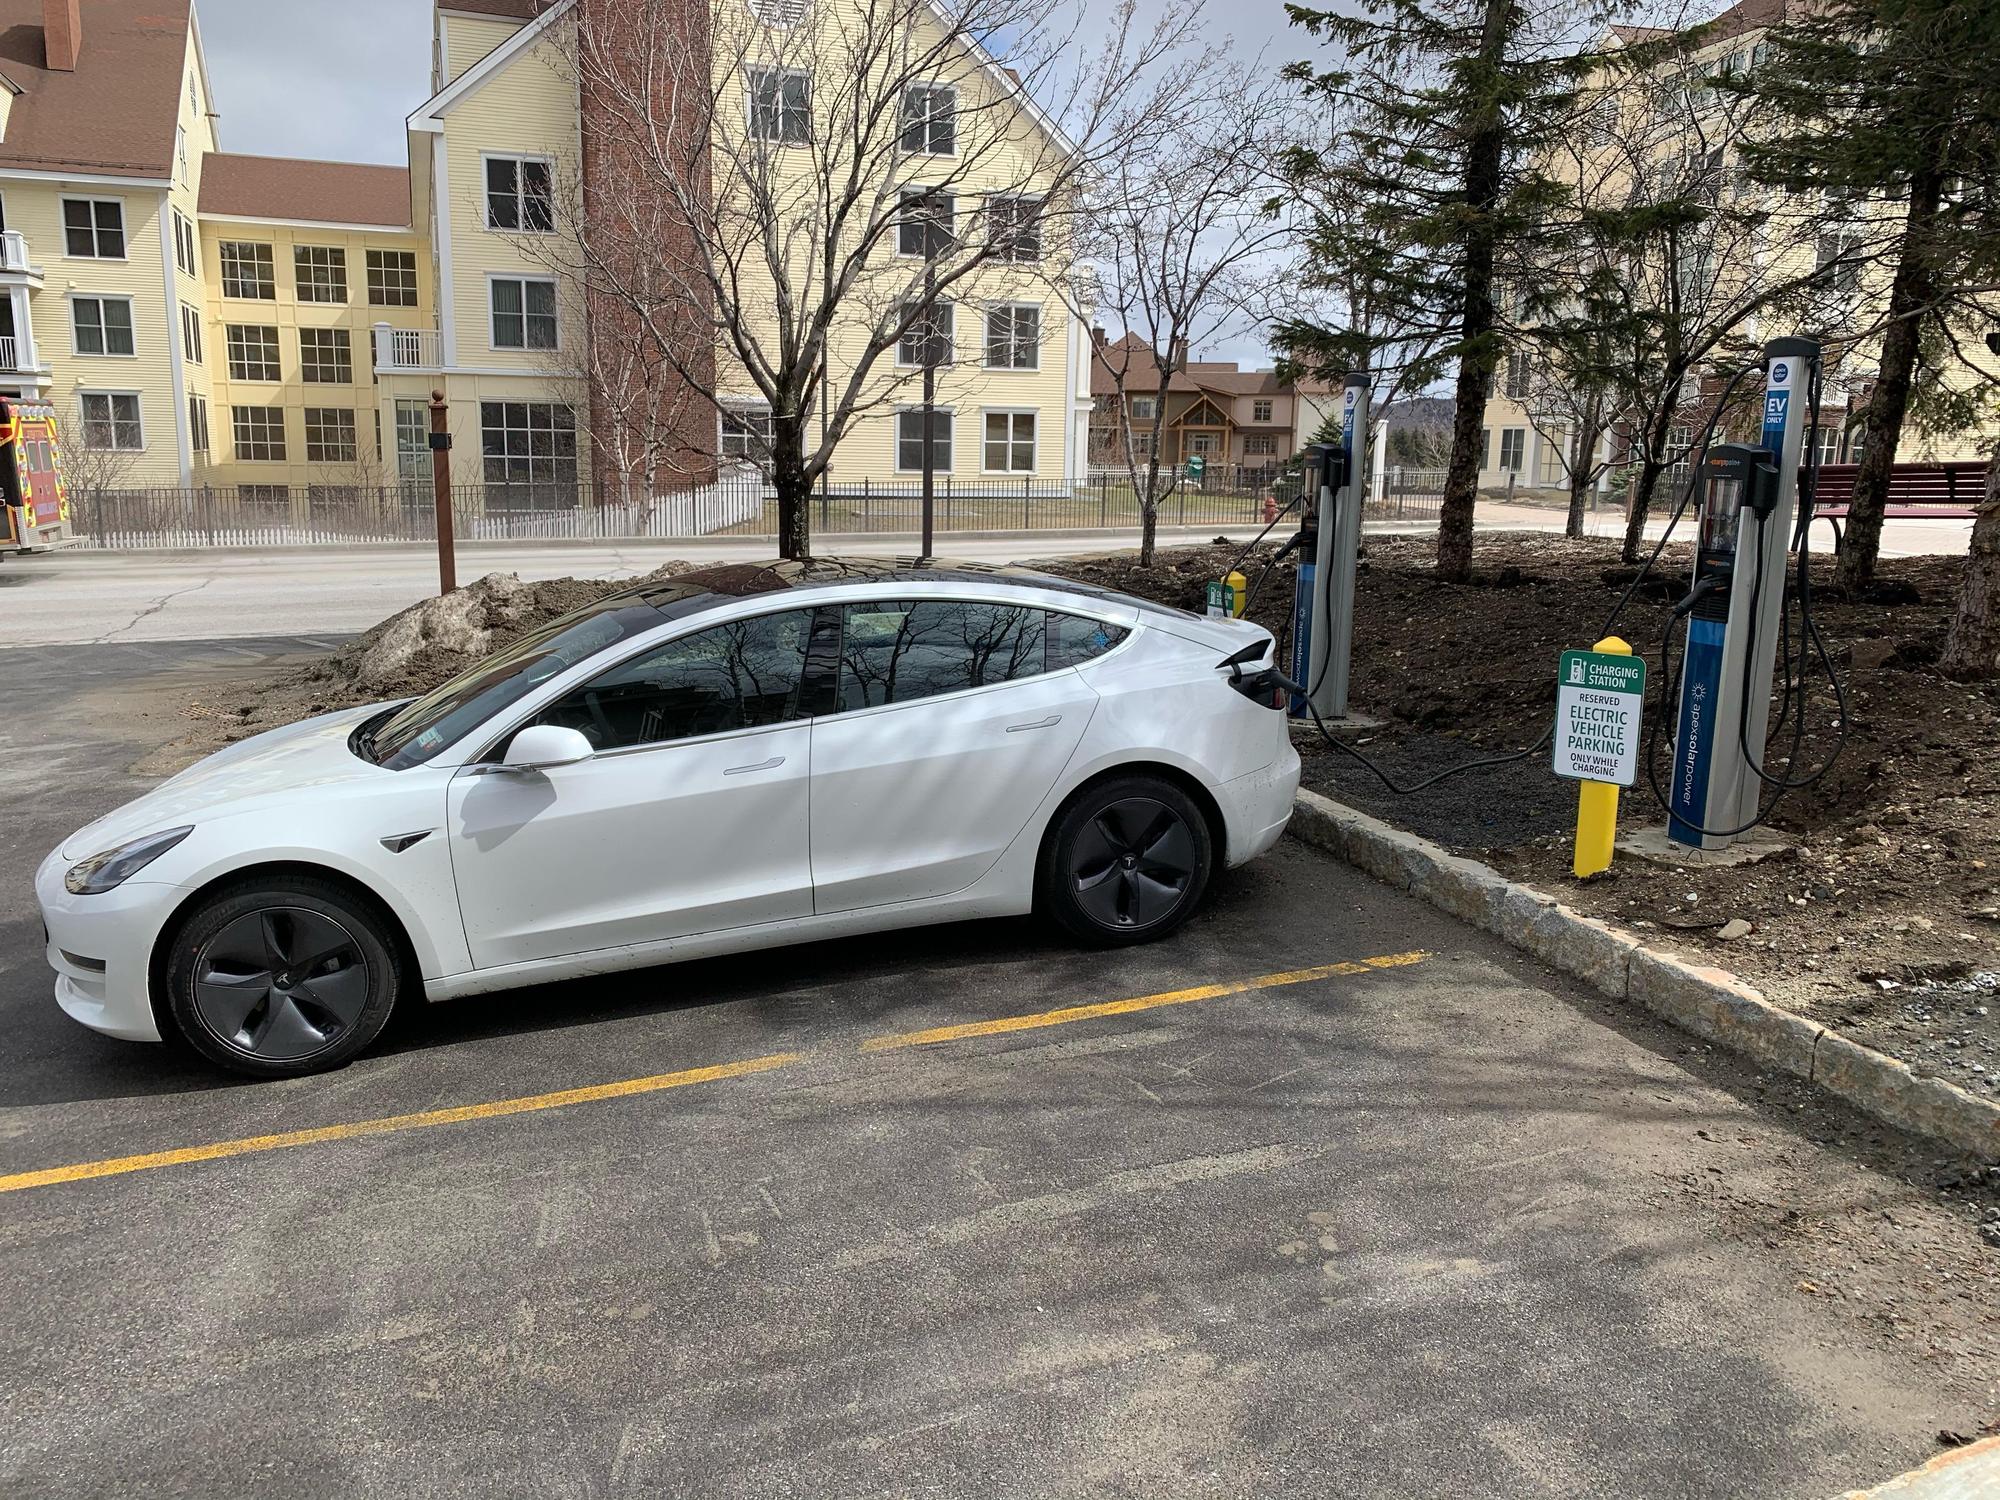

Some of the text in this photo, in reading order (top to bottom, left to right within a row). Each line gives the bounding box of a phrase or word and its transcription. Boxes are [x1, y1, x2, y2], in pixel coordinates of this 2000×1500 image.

[1767, 398, 1787, 412] EV
[1766, 416, 1784, 424] ONLY
[1589, 664, 1639, 679] CHARGING
[1588, 674, 1626, 689] STATION
[1579, 693, 1620, 706] RESERVED
[1570, 705, 1629, 725] ELECTRIC
[1571, 720, 1624, 740] VEHICLE
[1567, 735, 1625, 756] PARKING
[1570, 752, 1619, 768] ONLY WHILE
[1683, 703, 1701, 806] apexsolarpower
[1572, 762, 1615, 777] CHARGING
